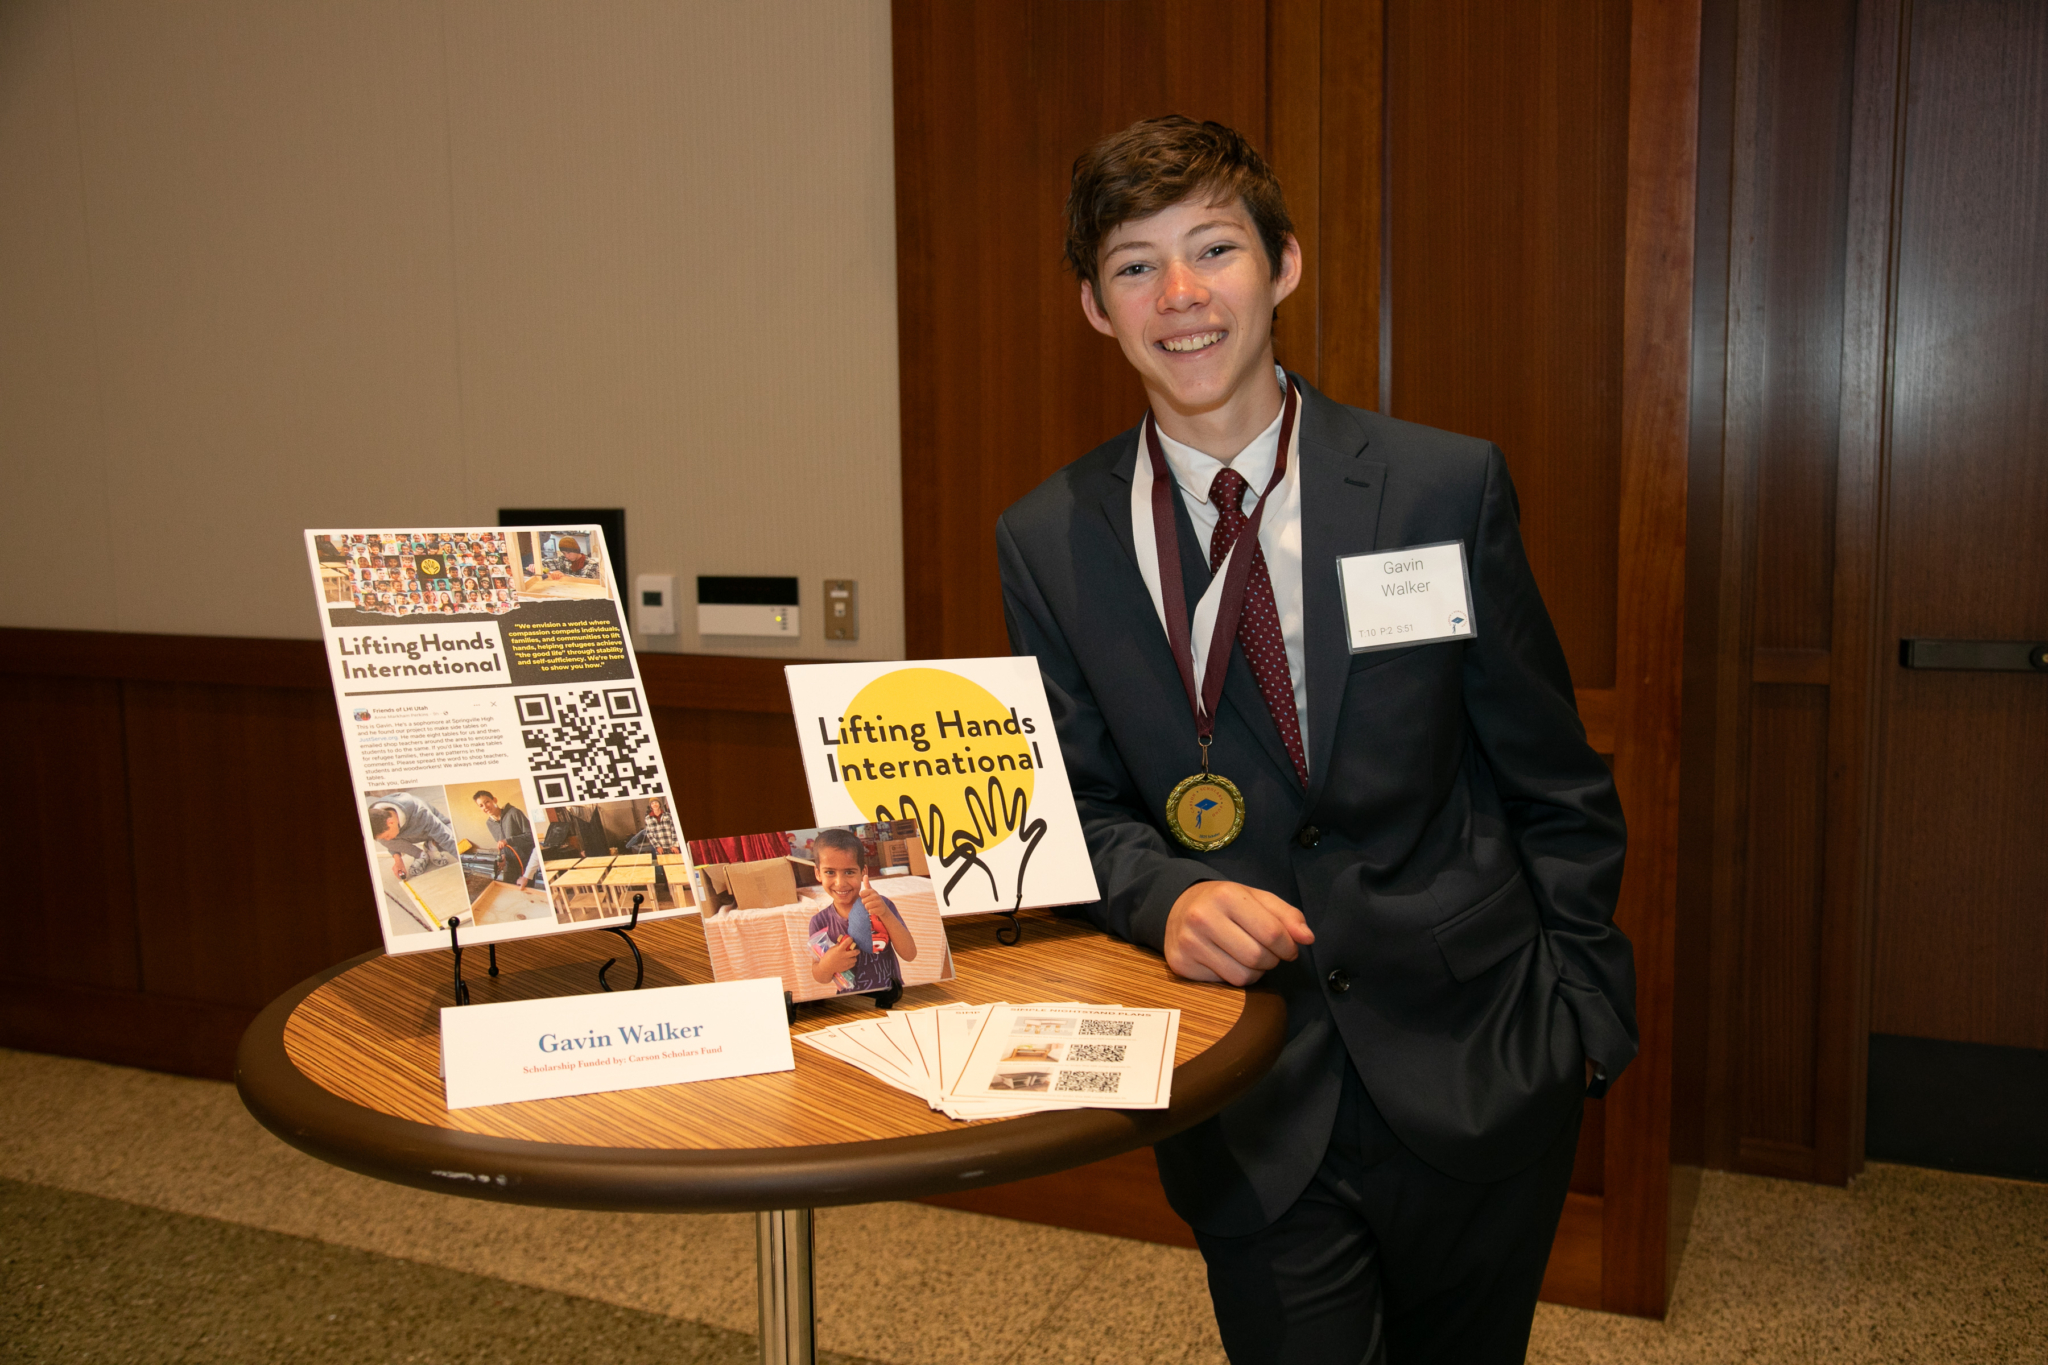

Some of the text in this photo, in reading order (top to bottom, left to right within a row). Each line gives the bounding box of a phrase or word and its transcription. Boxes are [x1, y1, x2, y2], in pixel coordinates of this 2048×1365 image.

[1383, 558, 1424, 575] Gavin
[1381, 580, 1431, 597] Walker
[338, 631, 495, 660] Lifting Hands
[1358, 628, 1377, 638] T:10
[342, 653, 502, 679] International
[532, 651, 551, 659] good
[532, 657, 587, 665] self-sufficiency.
[818, 707, 1036, 752] Lifting Hands
[826, 741, 1044, 783] International
[538, 1021, 704, 1054] Gavin Walker
[523, 1045, 722, 1074] Scholarship Funded by: Carson Scholars Fund
